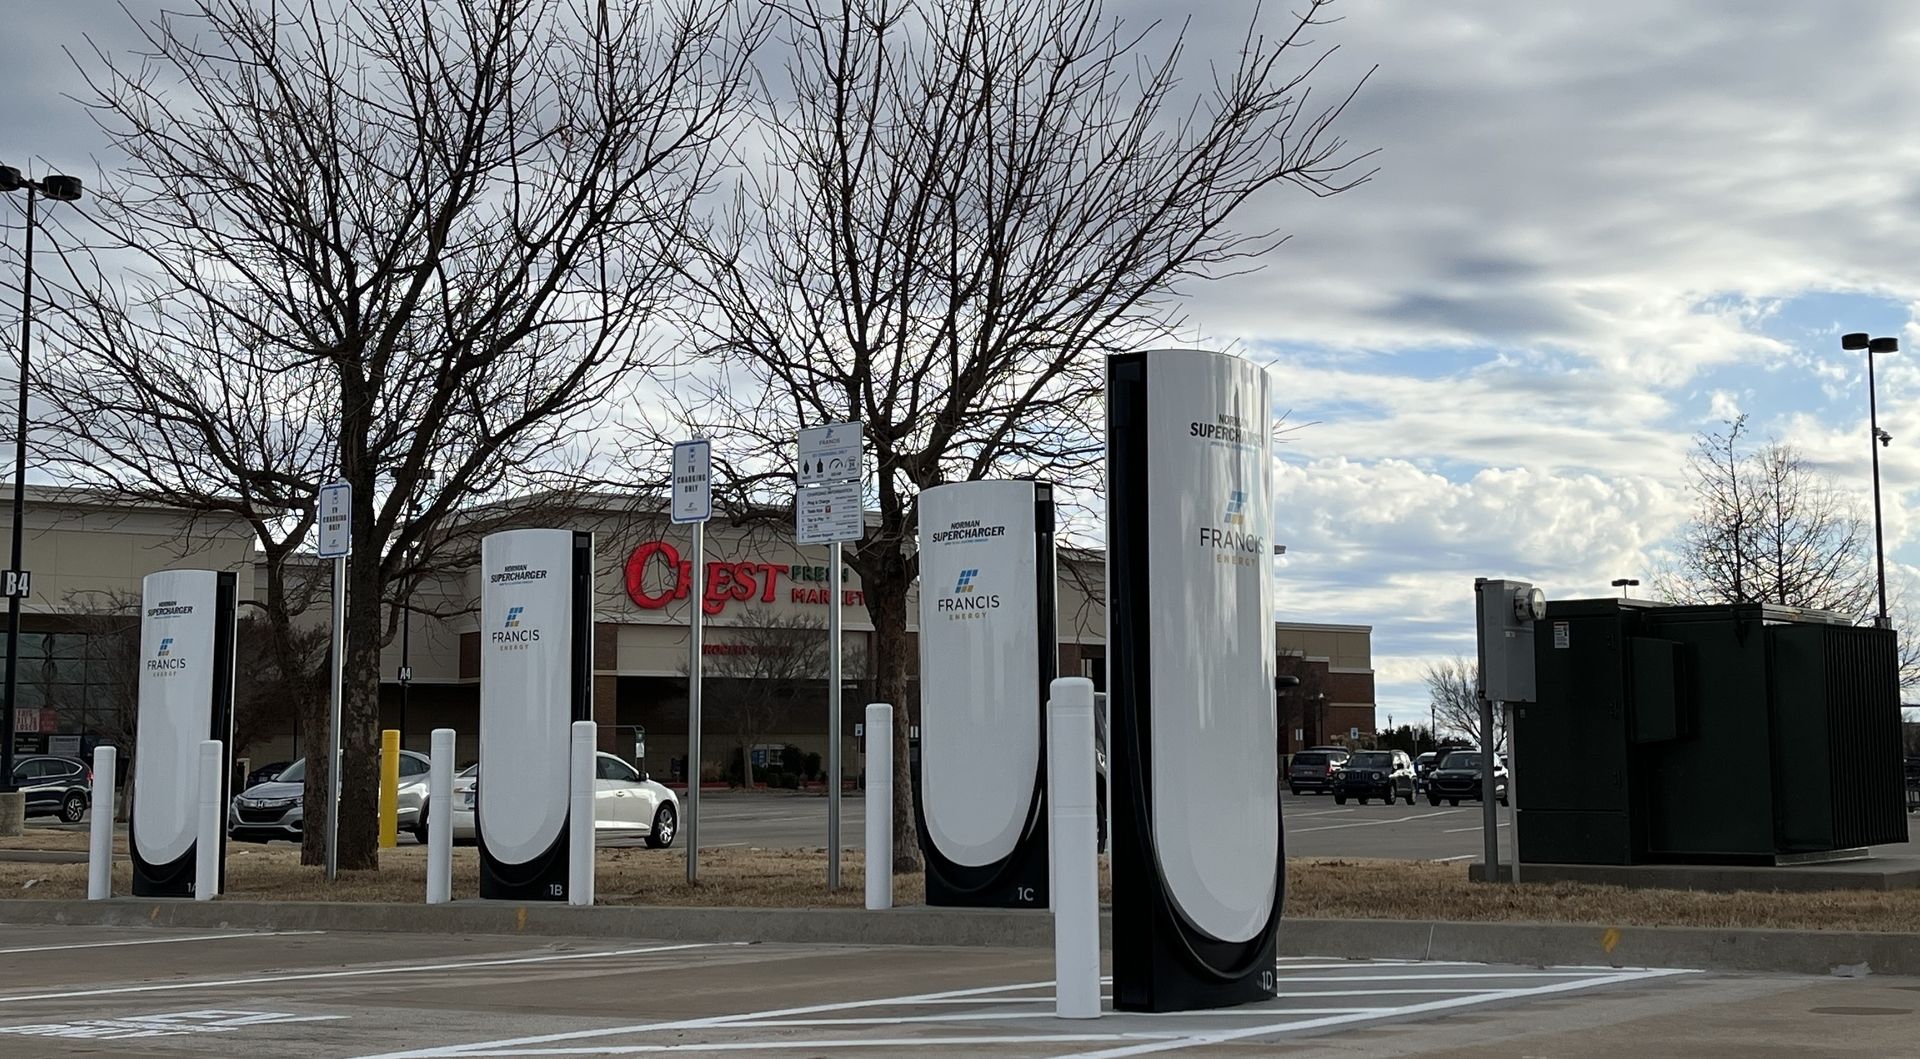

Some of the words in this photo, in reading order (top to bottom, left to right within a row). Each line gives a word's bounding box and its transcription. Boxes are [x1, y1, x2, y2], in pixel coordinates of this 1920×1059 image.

[688, 465, 695, 473] EV
[677, 474, 706, 484] CHARGING
[684, 485, 698, 493] ONLY
[951, 519, 980, 530] NORMAN
[932, 526, 1005, 543] SUPERCHARGER
[1200, 527, 1264, 554] FRANCIS
[1216, 554, 1256, 566] ENERGY
[504, 564, 528, 573] NORMAN
[490, 569, 547, 584] SUPERCHARGER
[6, 571, 29, 597] B4
[792, 588, 865, 606] MARET
[938, 594, 1000, 612] FRANCIS
[147, 606, 193, 617] SUPERCHARGER
[949, 611, 987, 621] ENERGY
[492, 629, 540, 643] FRANCIS
[500, 643, 529, 651] ENERGY
[147, 658, 186, 670] FRANCIS
[550, 884, 563, 896] 1B
[1018, 886, 1034, 901] 1C
[1262, 970, 1273, 991] 1D
